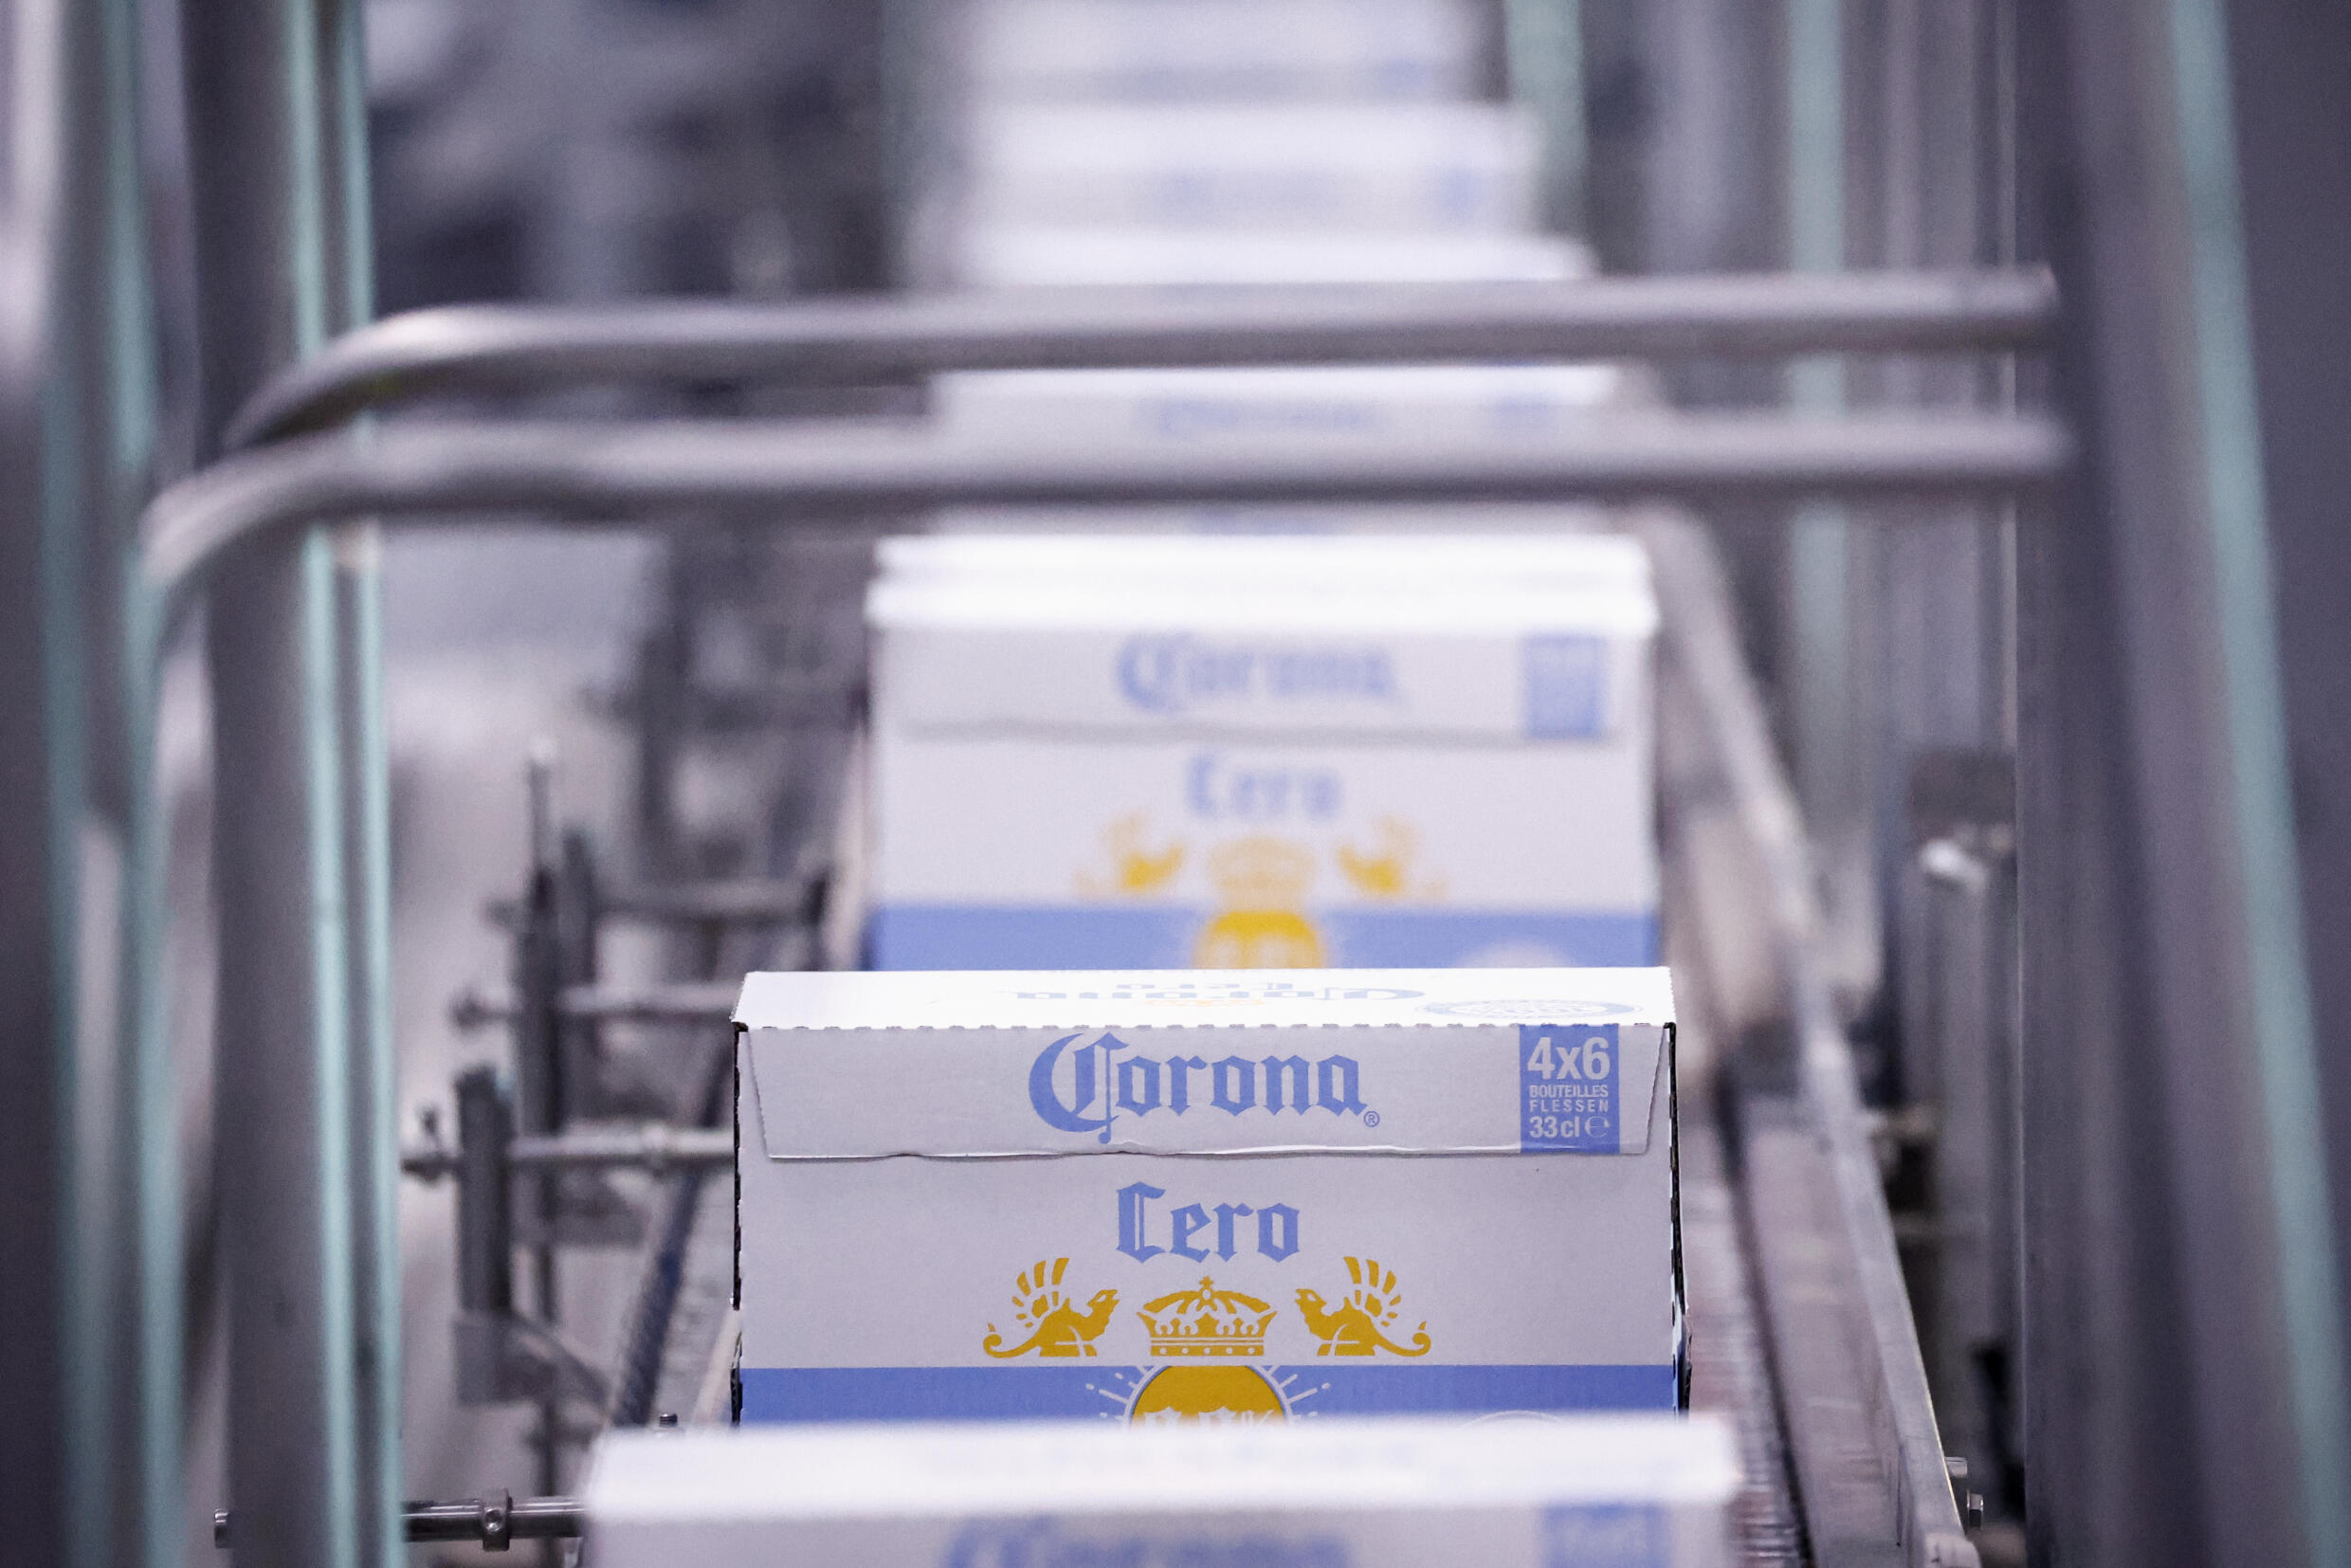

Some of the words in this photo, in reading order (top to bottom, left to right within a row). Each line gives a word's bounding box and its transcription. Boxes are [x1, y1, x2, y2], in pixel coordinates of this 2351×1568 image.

[1526, 1036, 1612, 1081] 4x6
[1529, 1085, 1609, 1098] BOUTEILLES
[1529, 1099, 1609, 1113] FLESSEN
[1116, 1181, 1300, 1264] Cero
